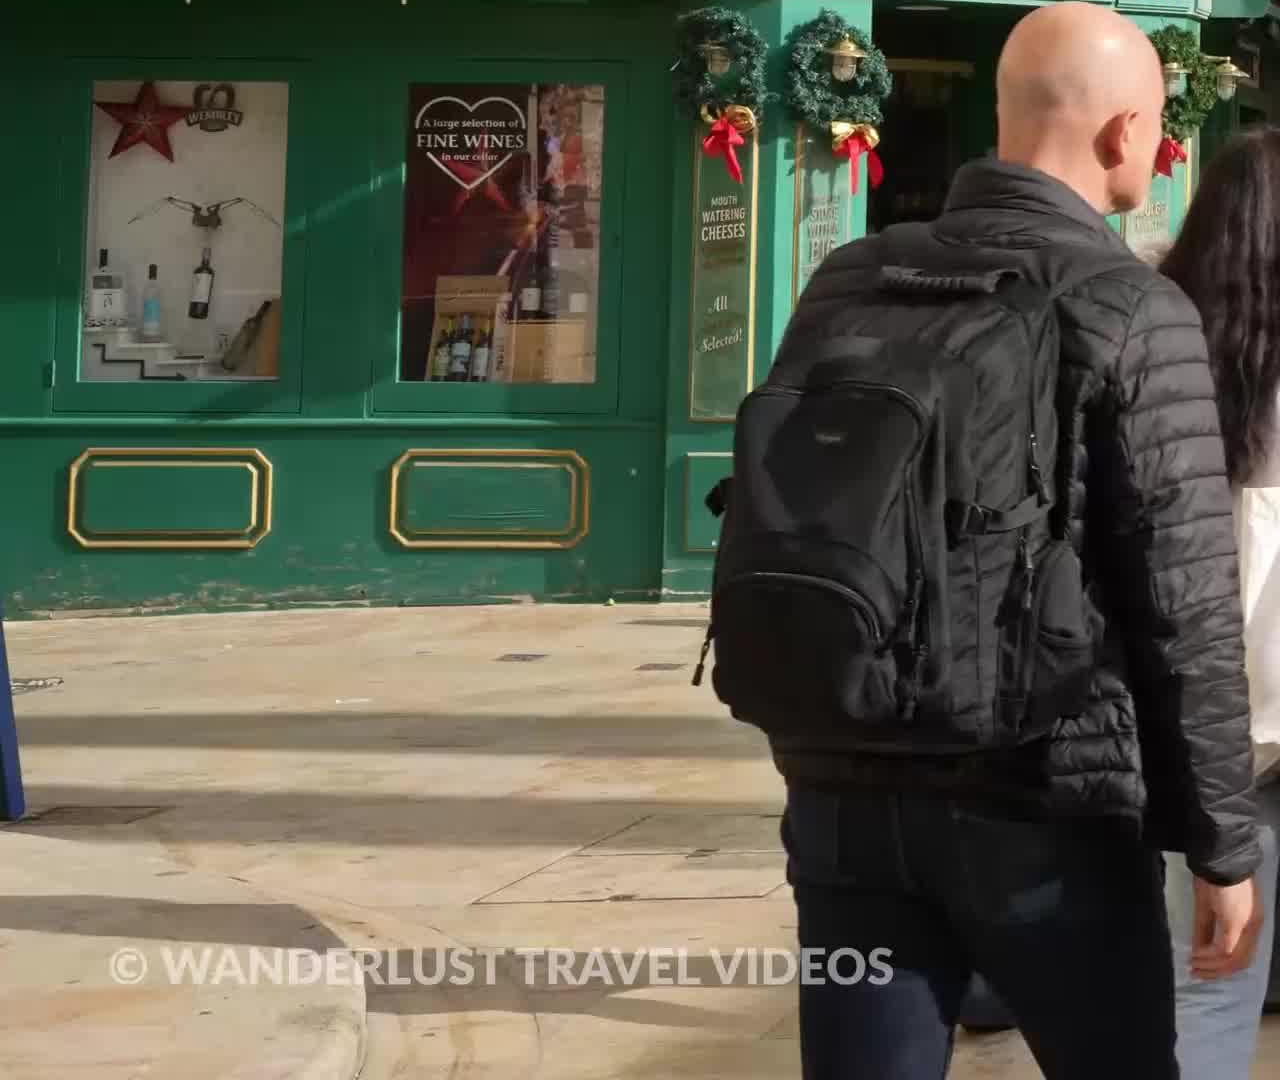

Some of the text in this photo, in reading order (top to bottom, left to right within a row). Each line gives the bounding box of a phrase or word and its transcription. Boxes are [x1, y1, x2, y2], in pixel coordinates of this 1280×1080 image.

[423, 118, 519, 129] A large selection of
[416, 133, 525, 149] FINE WINES
[441, 152, 451, 161] in
[472, 152, 499, 161] cellar
[711, 195, 738, 207] MOUTH
[702, 206, 746, 223] WATERING
[701, 222, 746, 242] CHEESES
[709, 295, 728, 313] All
[702, 328, 744, 353] Selected!
